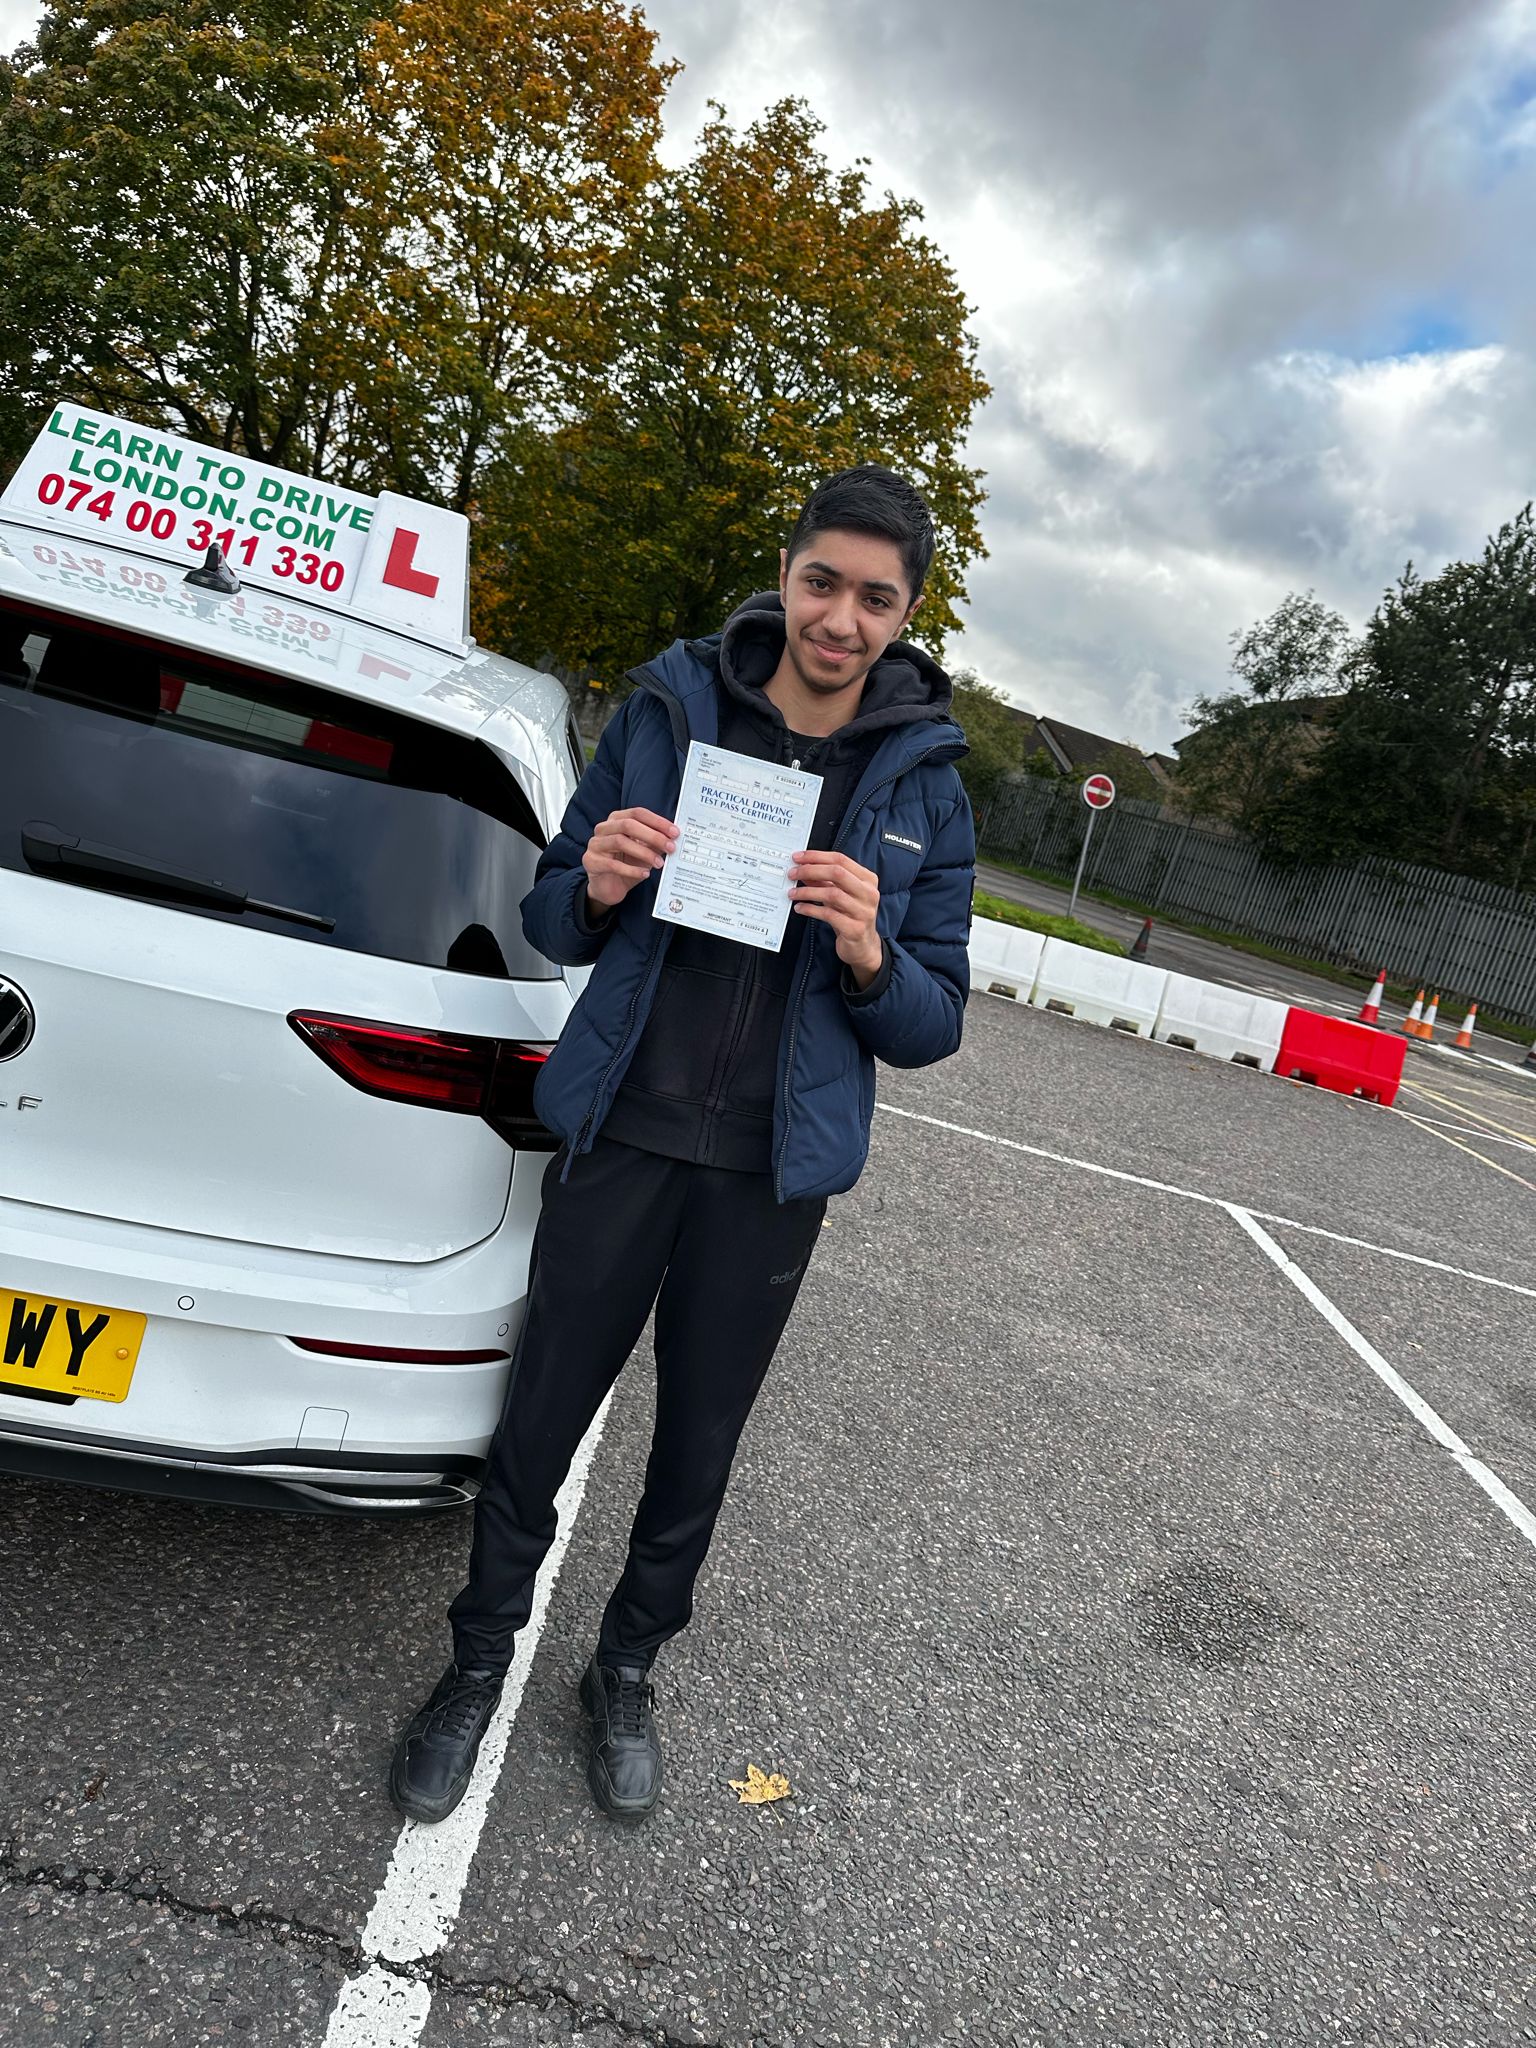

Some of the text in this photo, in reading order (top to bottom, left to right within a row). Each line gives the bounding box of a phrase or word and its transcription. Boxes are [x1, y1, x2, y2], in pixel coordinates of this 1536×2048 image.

[47, 410, 374, 533] LEARN TO DRIVE
[69, 449, 336, 551] LONDON.COM
[38, 473, 344, 592] 074 00 311 330
[382, 527, 440, 598] L
[700, 795, 718, 806] TEST
[720, 801, 739, 812] PASS
[741, 807, 792, 827] CERTIFICATE
[701, 786, 750, 806] PRACTICAL
[752, 801, 794, 818] DRIVING
[884, 833, 922, 850] HOLLISTER
[3, 1297, 111, 1377] WY
